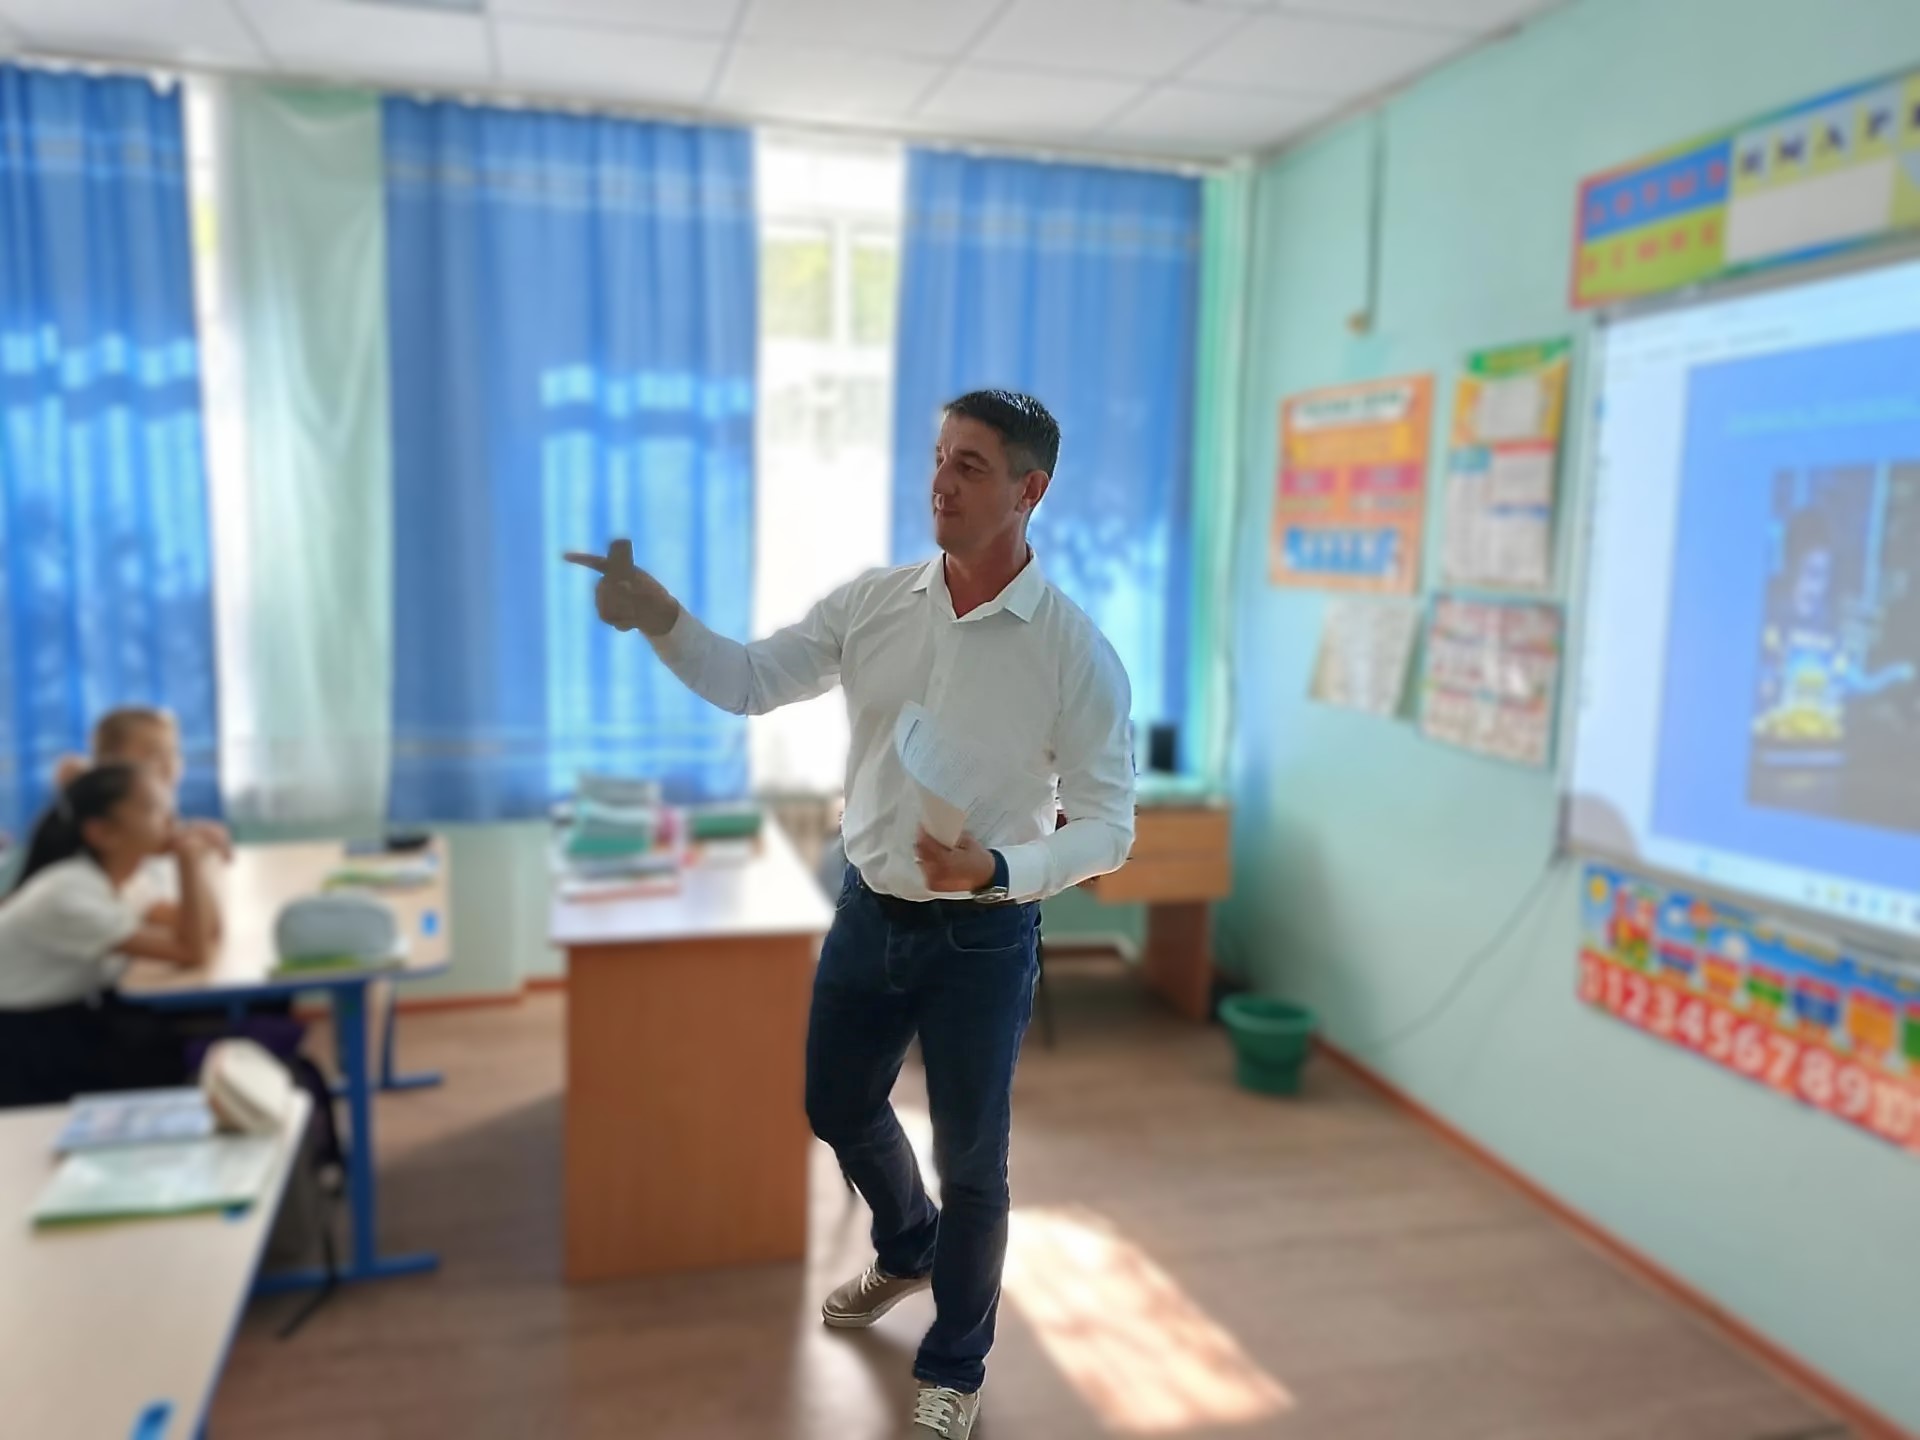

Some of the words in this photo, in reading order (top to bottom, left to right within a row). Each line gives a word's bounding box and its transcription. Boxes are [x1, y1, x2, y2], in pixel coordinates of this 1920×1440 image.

[1607, 965, 1623, 1015] 1
[1624, 973, 1648, 1022] 2
[1650, 986, 1677, 1033] 3
[1678, 1001, 1704, 1043] 4
[1706, 1011, 1733, 1058] 5
[1733, 1023, 1764, 1072] 6
[1768, 1034, 1798, 1089] 7
[1801, 1051, 1836, 1103] 8
[1838, 1064, 1870, 1115] 9
